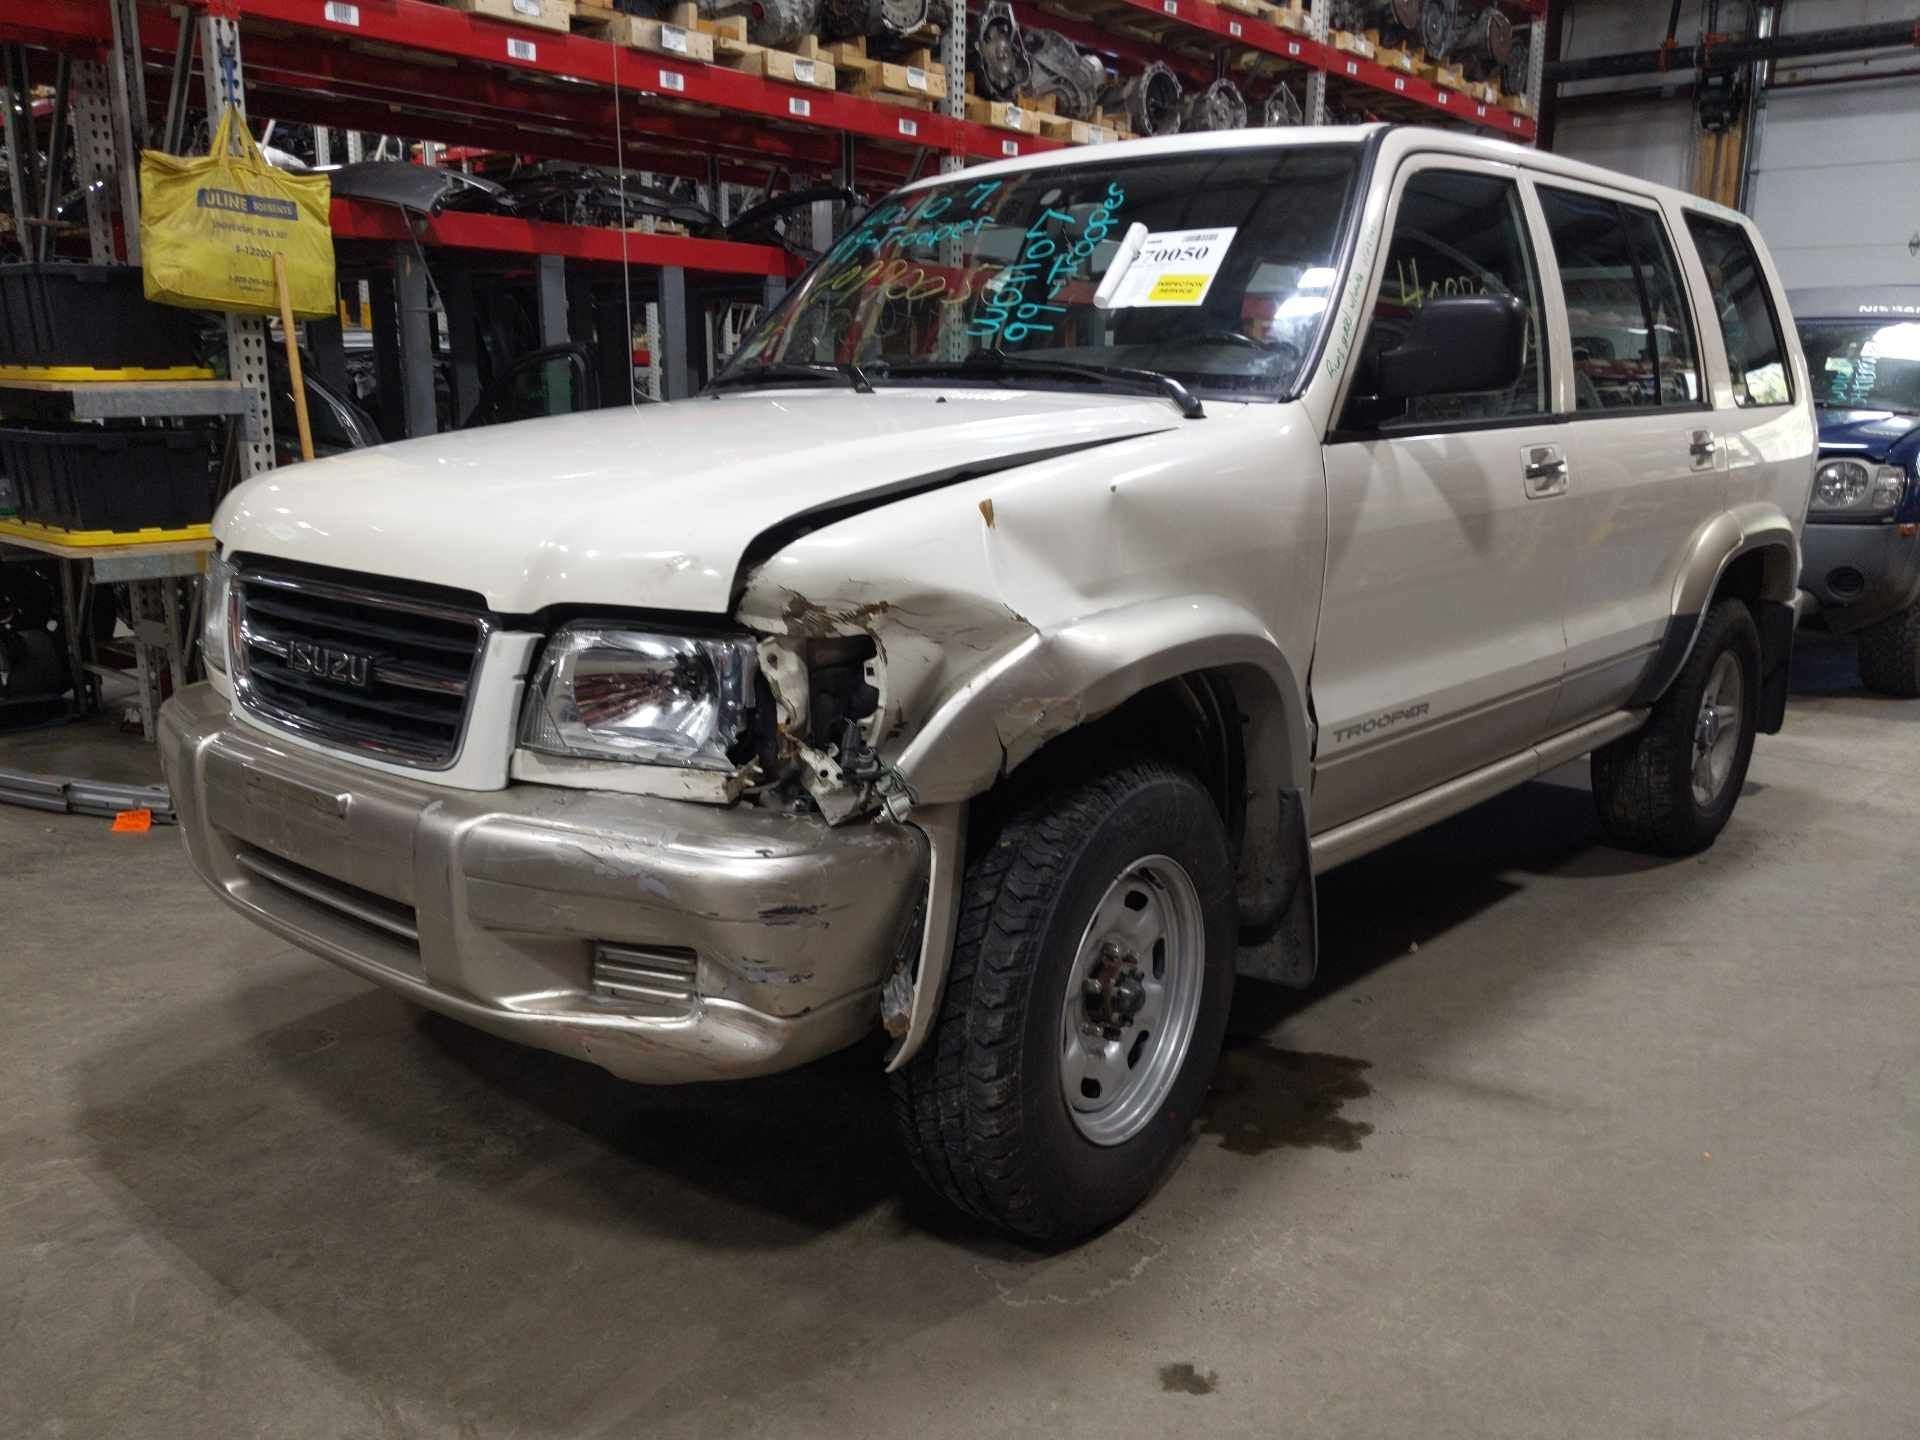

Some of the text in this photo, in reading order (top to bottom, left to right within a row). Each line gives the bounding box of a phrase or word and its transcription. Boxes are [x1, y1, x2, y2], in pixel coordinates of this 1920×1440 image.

[206, 190, 248, 212] ULINE
[287, 640, 370, 687] ISUZU
[1333, 703, 1430, 743] TROOPER
